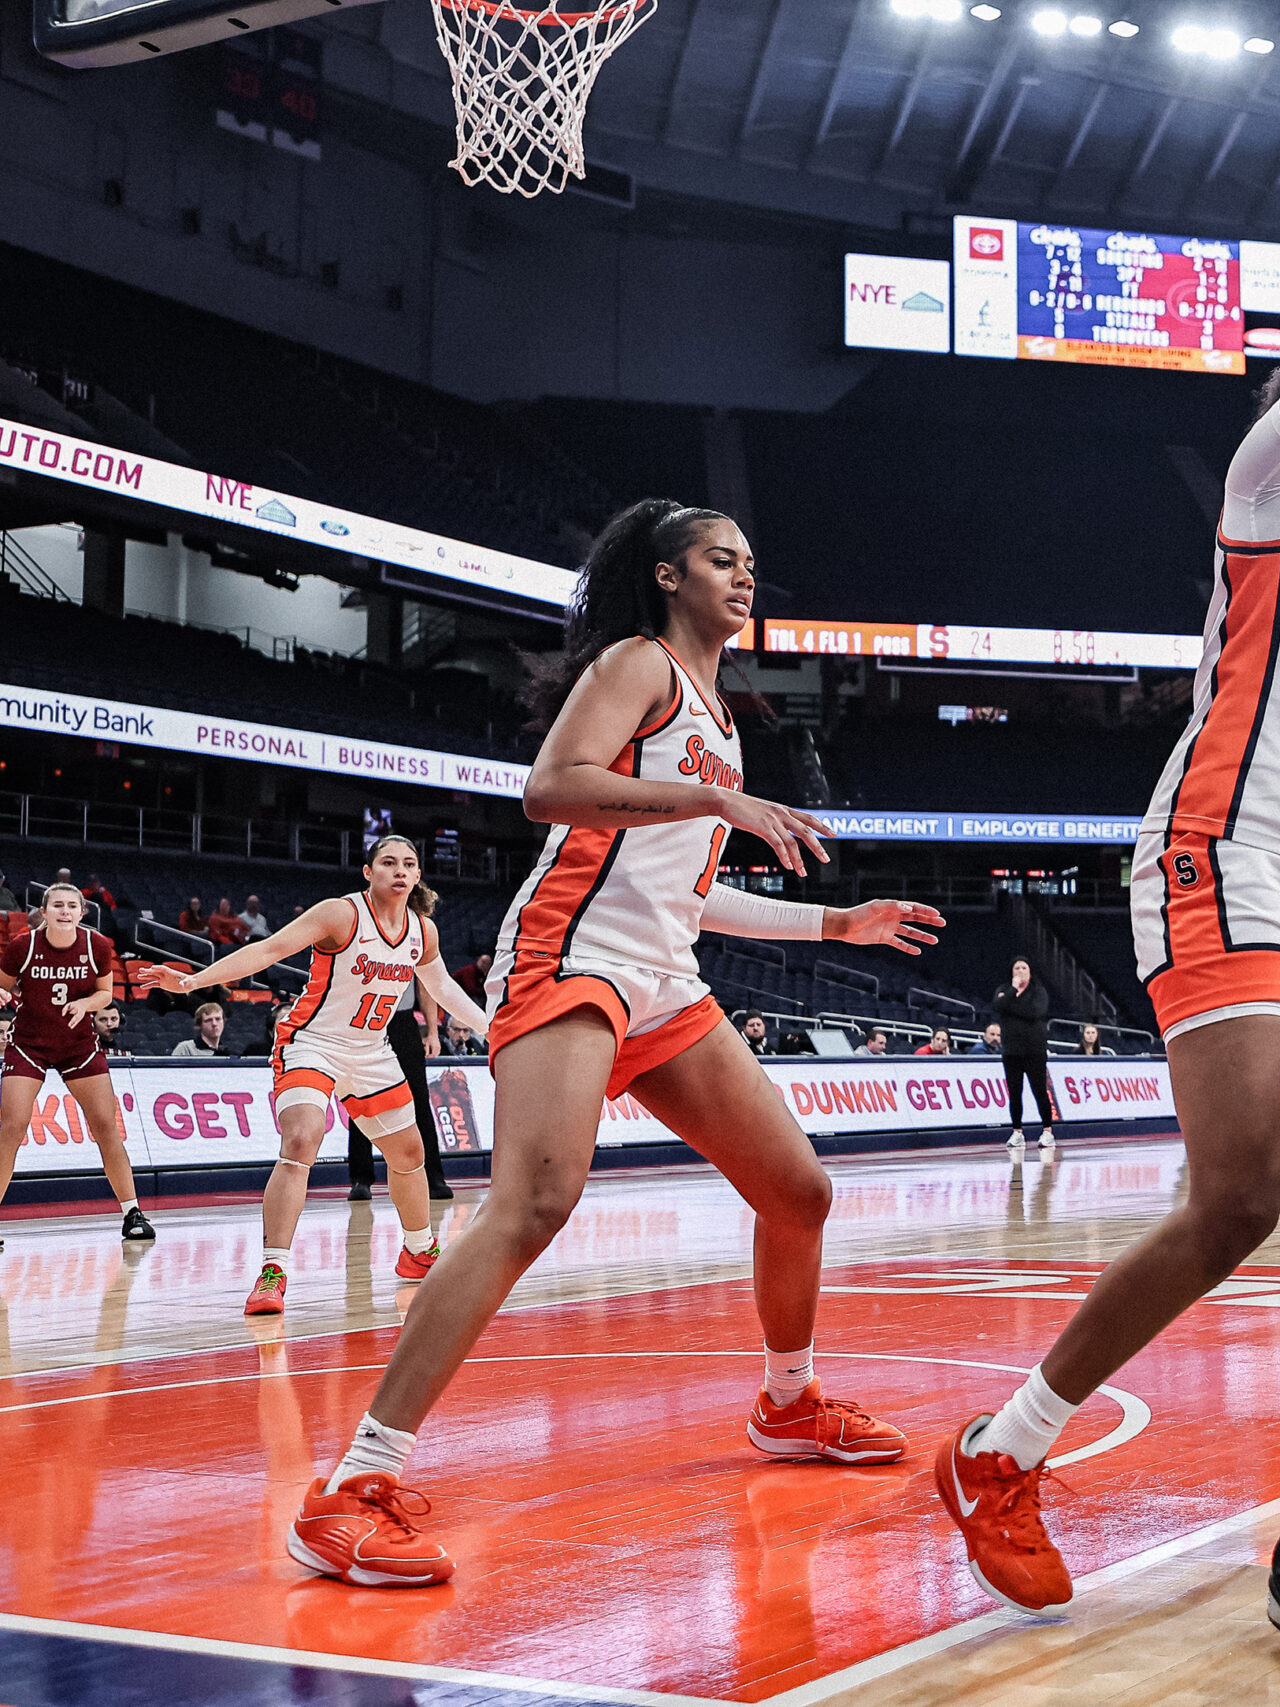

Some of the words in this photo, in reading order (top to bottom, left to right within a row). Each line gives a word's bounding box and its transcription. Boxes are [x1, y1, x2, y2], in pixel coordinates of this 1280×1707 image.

[851, 283, 897, 305] NYE
[206, 474, 253, 511] NYE
[802, 629, 815, 653] 4
[852, 631, 862, 654] 1
[970, 631, 992, 656] 24
[94, 706, 153, 736] Bank
[197, 726, 308, 759] PERSONAL
[339, 748, 430, 777] BUSINESS
[456, 765, 524, 790] WEALTH
[821, 817, 939, 835] ANAGEMENT
[962, 821, 1059, 838] EMPLOYEE
[1064, 821, 1139, 839] BENEFIT
[693, 823, 726, 899] 1
[1173, 852, 1198, 886] S
[31, 966, 89, 979] COLGATE
[51, 983, 68, 1005] 3
[350, 992, 398, 1031] 15
[791, 1079, 898, 1115] DUNKIN'
[906, 1079, 952, 1110] GET
[1096, 1078, 1161, 1102] DUNKIN'
[153, 1092, 254, 1140] GET
[437, 1106, 457, 1148] ICED
